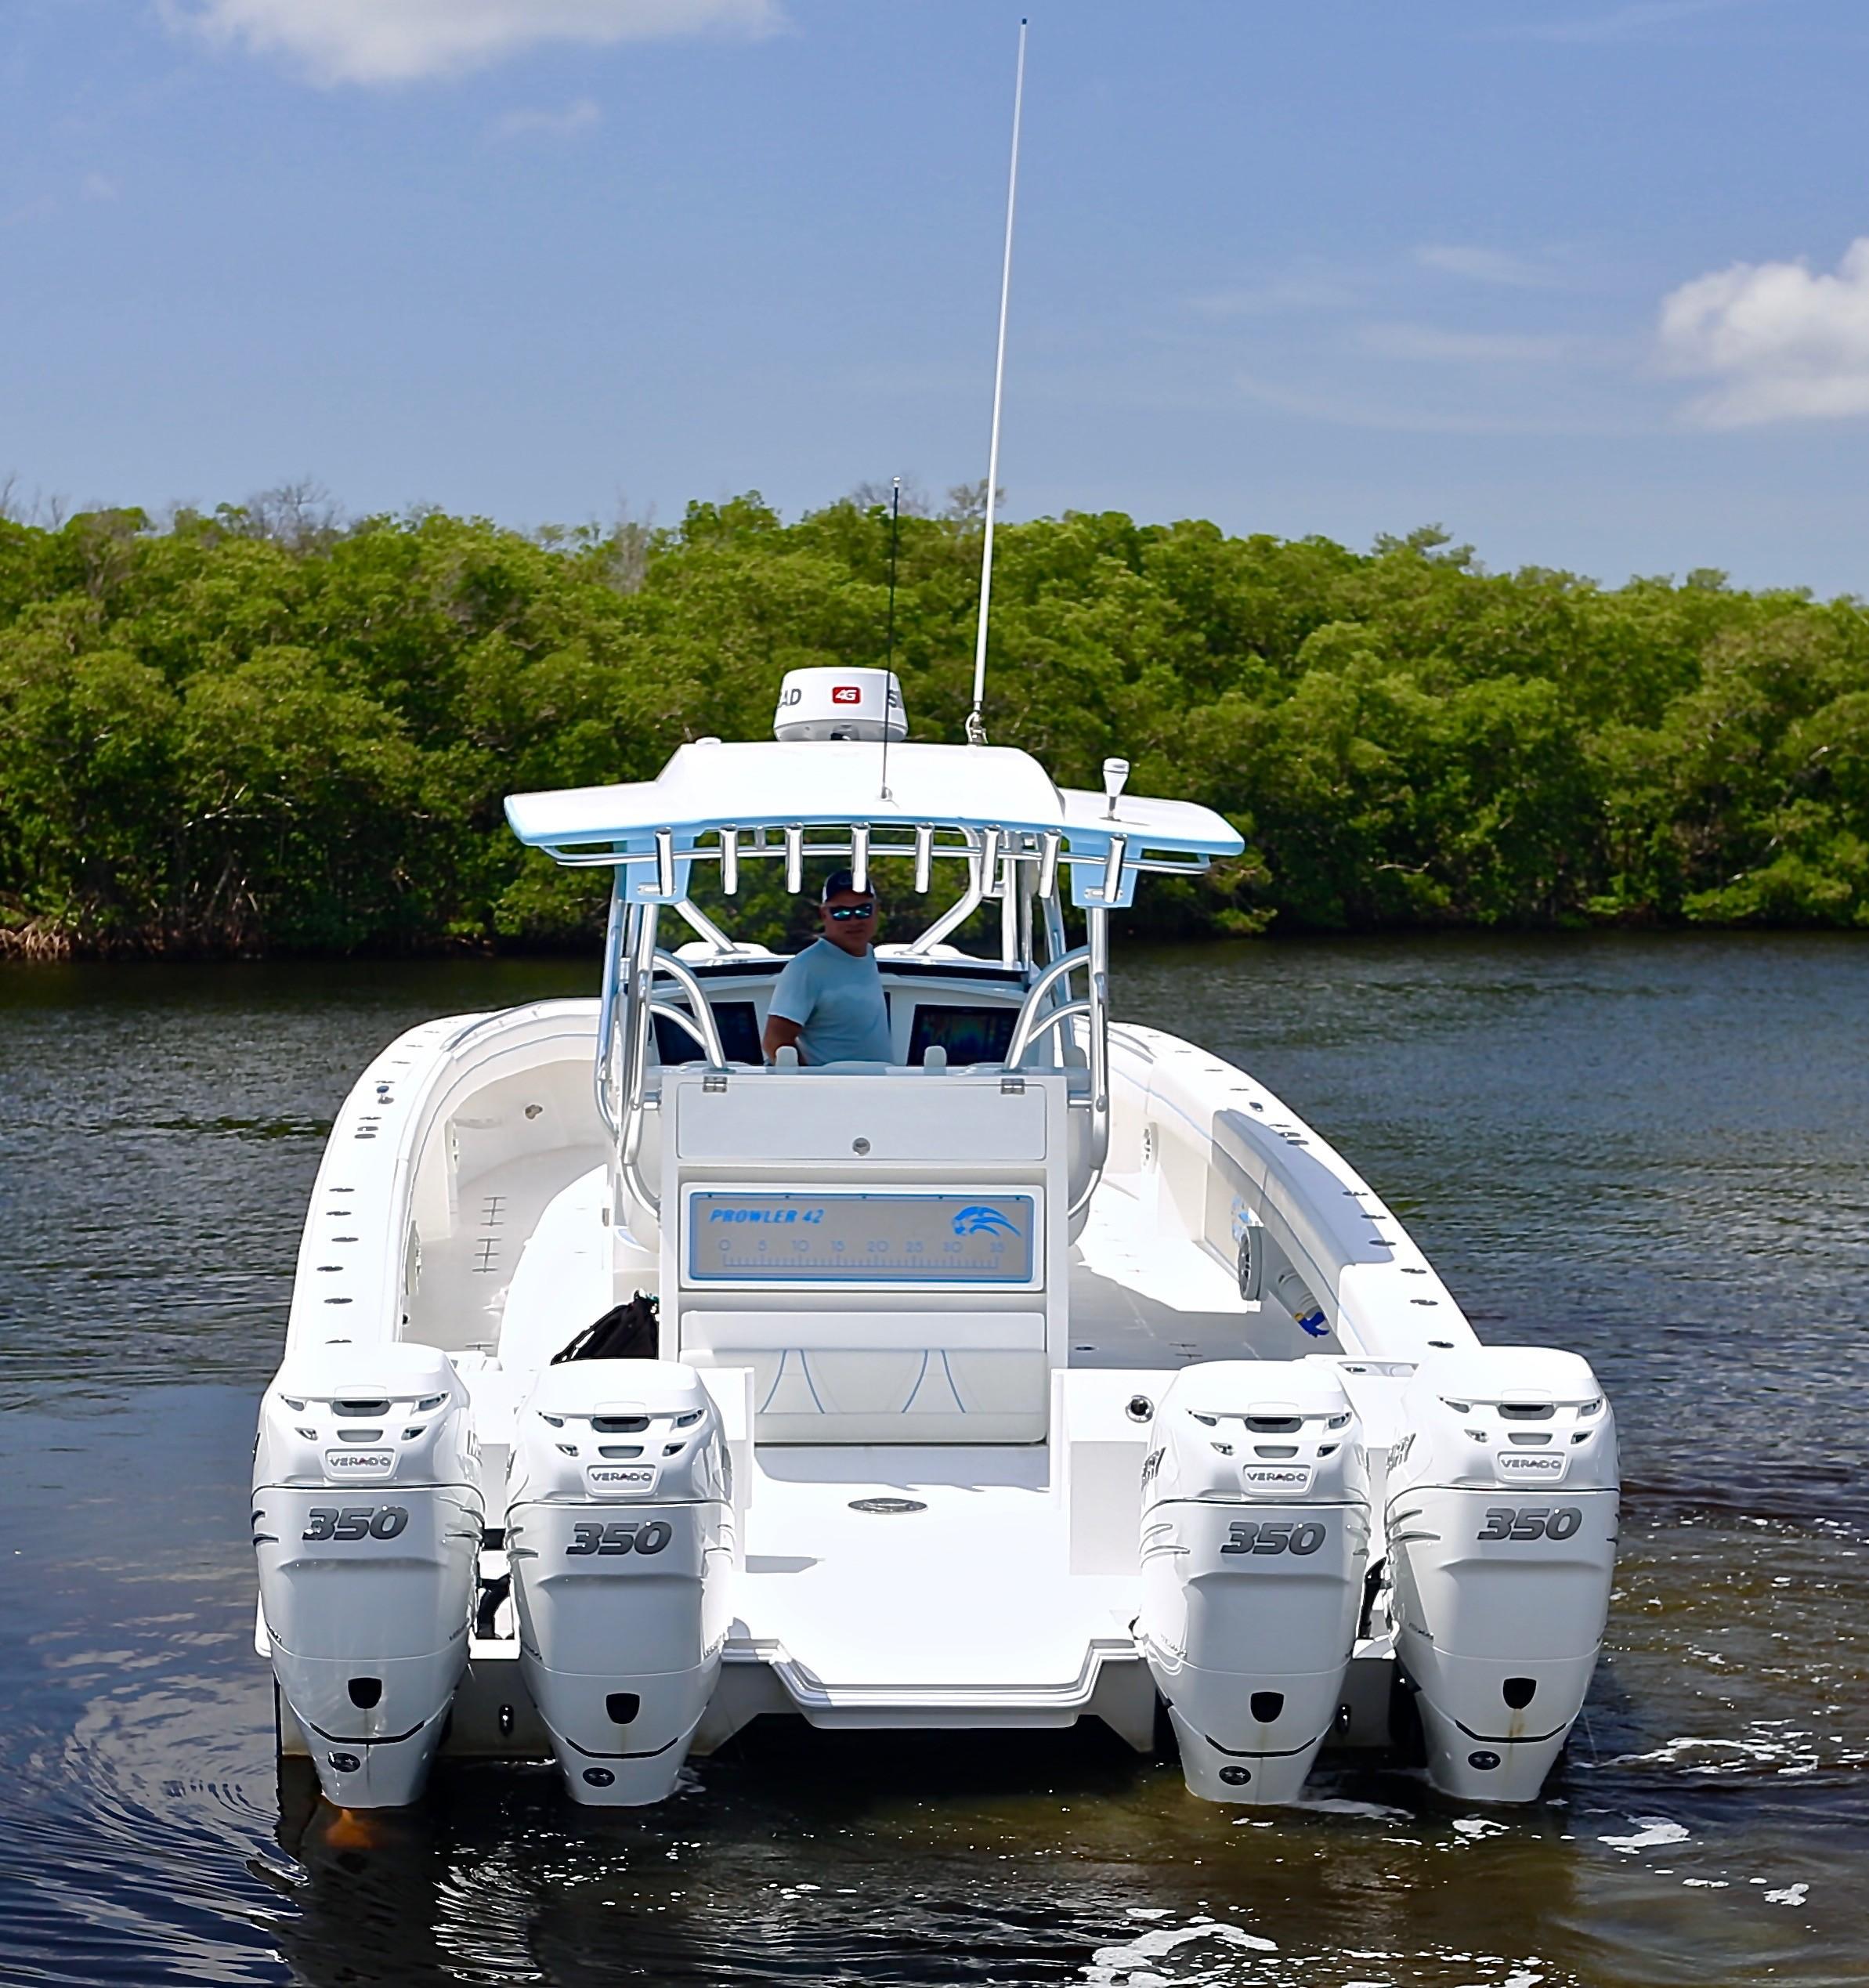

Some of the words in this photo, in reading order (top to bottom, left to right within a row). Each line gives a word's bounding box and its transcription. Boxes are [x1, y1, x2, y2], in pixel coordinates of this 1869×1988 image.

[834, 689, 858, 701] 4G
[710, 1209, 798, 1224] PROWLER
[802, 1209, 825, 1224] 42
[718, 1239, 731, 1252] 0
[757, 1239, 767, 1252] 5
[792, 1239, 809, 1252] 10
[831, 1240, 846, 1252] 15
[867, 1240, 890, 1253] 20
[906, 1241, 924, 1253] 25
[330, 1457, 392, 1467] VERADO
[1501, 1458, 1562, 1469] VERADO
[591, 1472, 653, 1482] VERADO
[1246, 1472, 1307, 1482] VERADO
[302, 1506, 410, 1541] 350
[1477, 1507, 1583, 1541] 350
[566, 1521, 673, 1556] 350
[1220, 1521, 1326, 1556] 350
